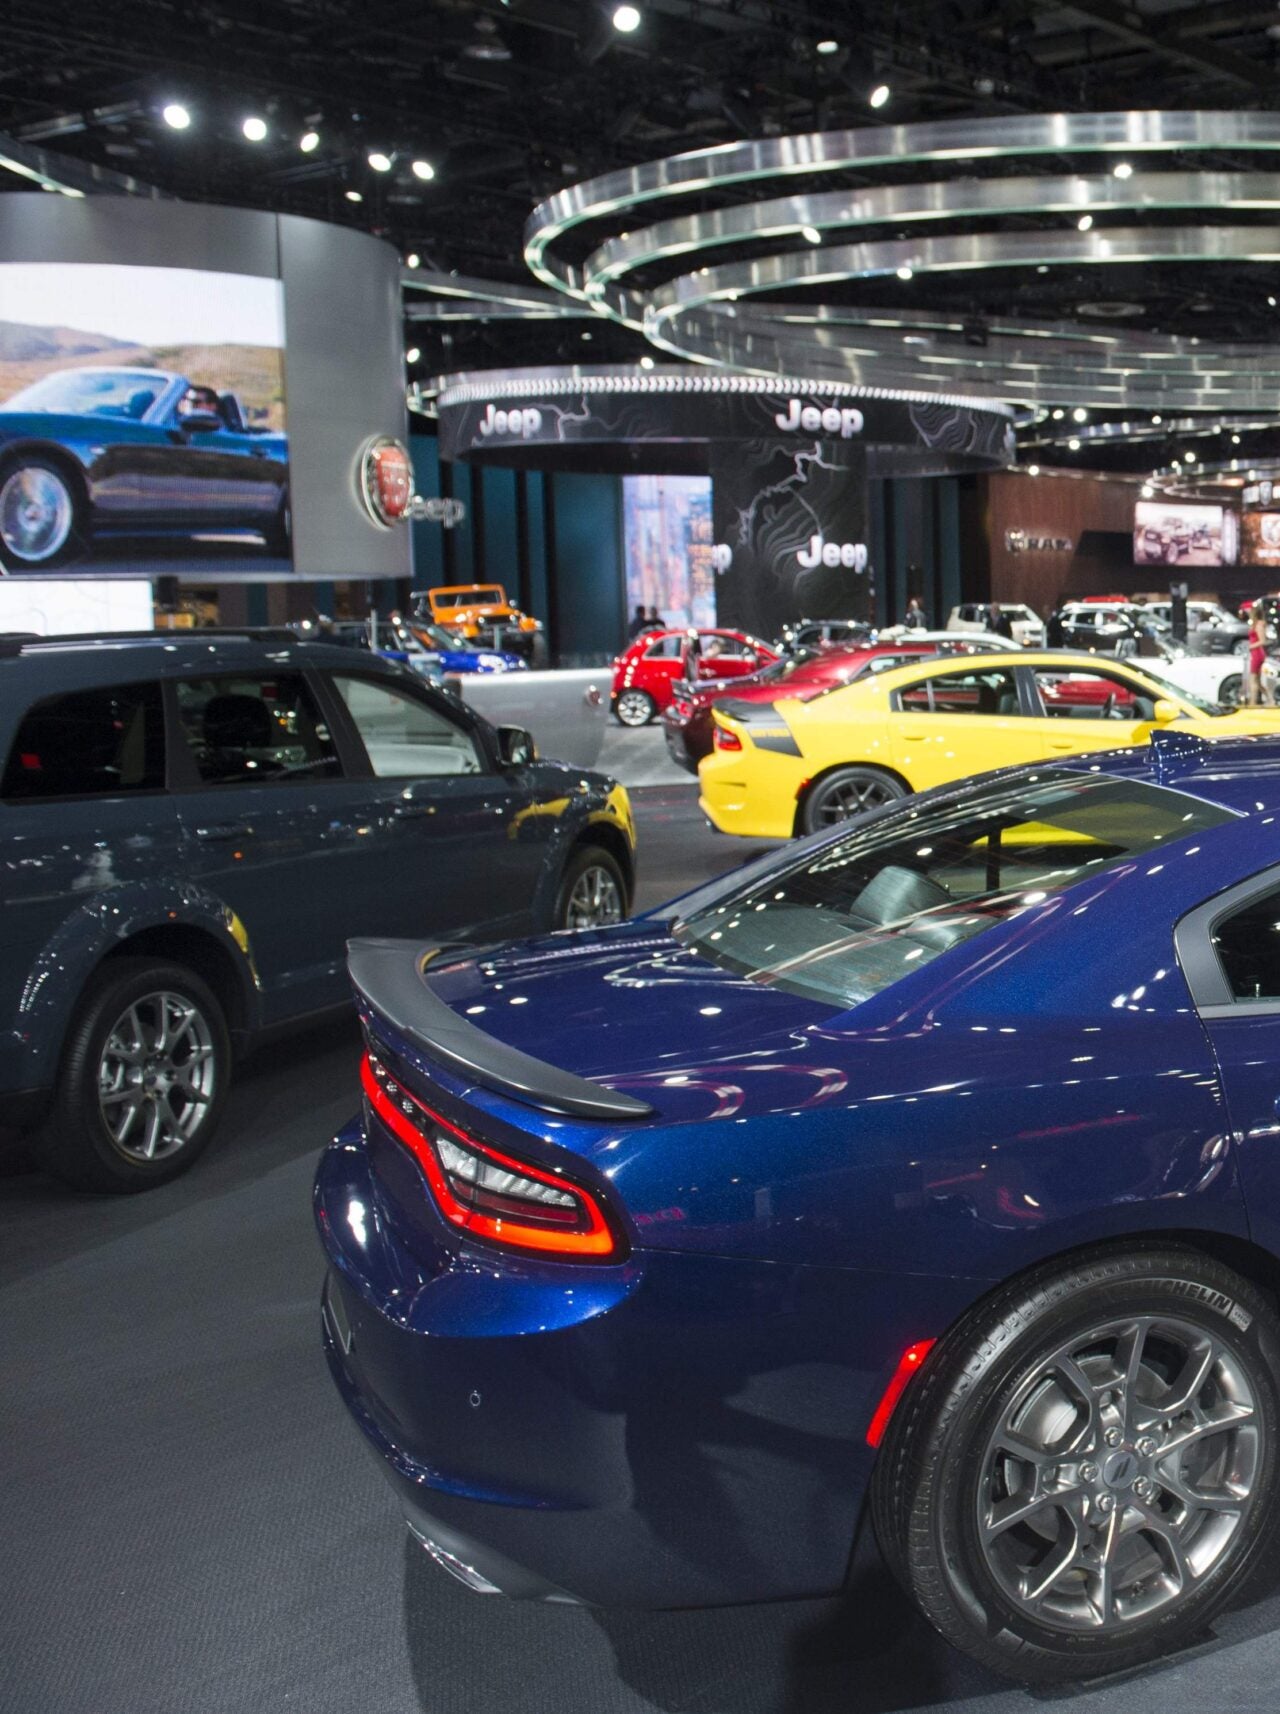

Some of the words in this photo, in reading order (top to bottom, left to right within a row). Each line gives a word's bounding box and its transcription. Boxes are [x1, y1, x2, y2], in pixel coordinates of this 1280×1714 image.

[480, 404, 542, 437] Jeep
[775, 399, 864, 438] Jeep
[797, 535, 868, 574] Jeep
